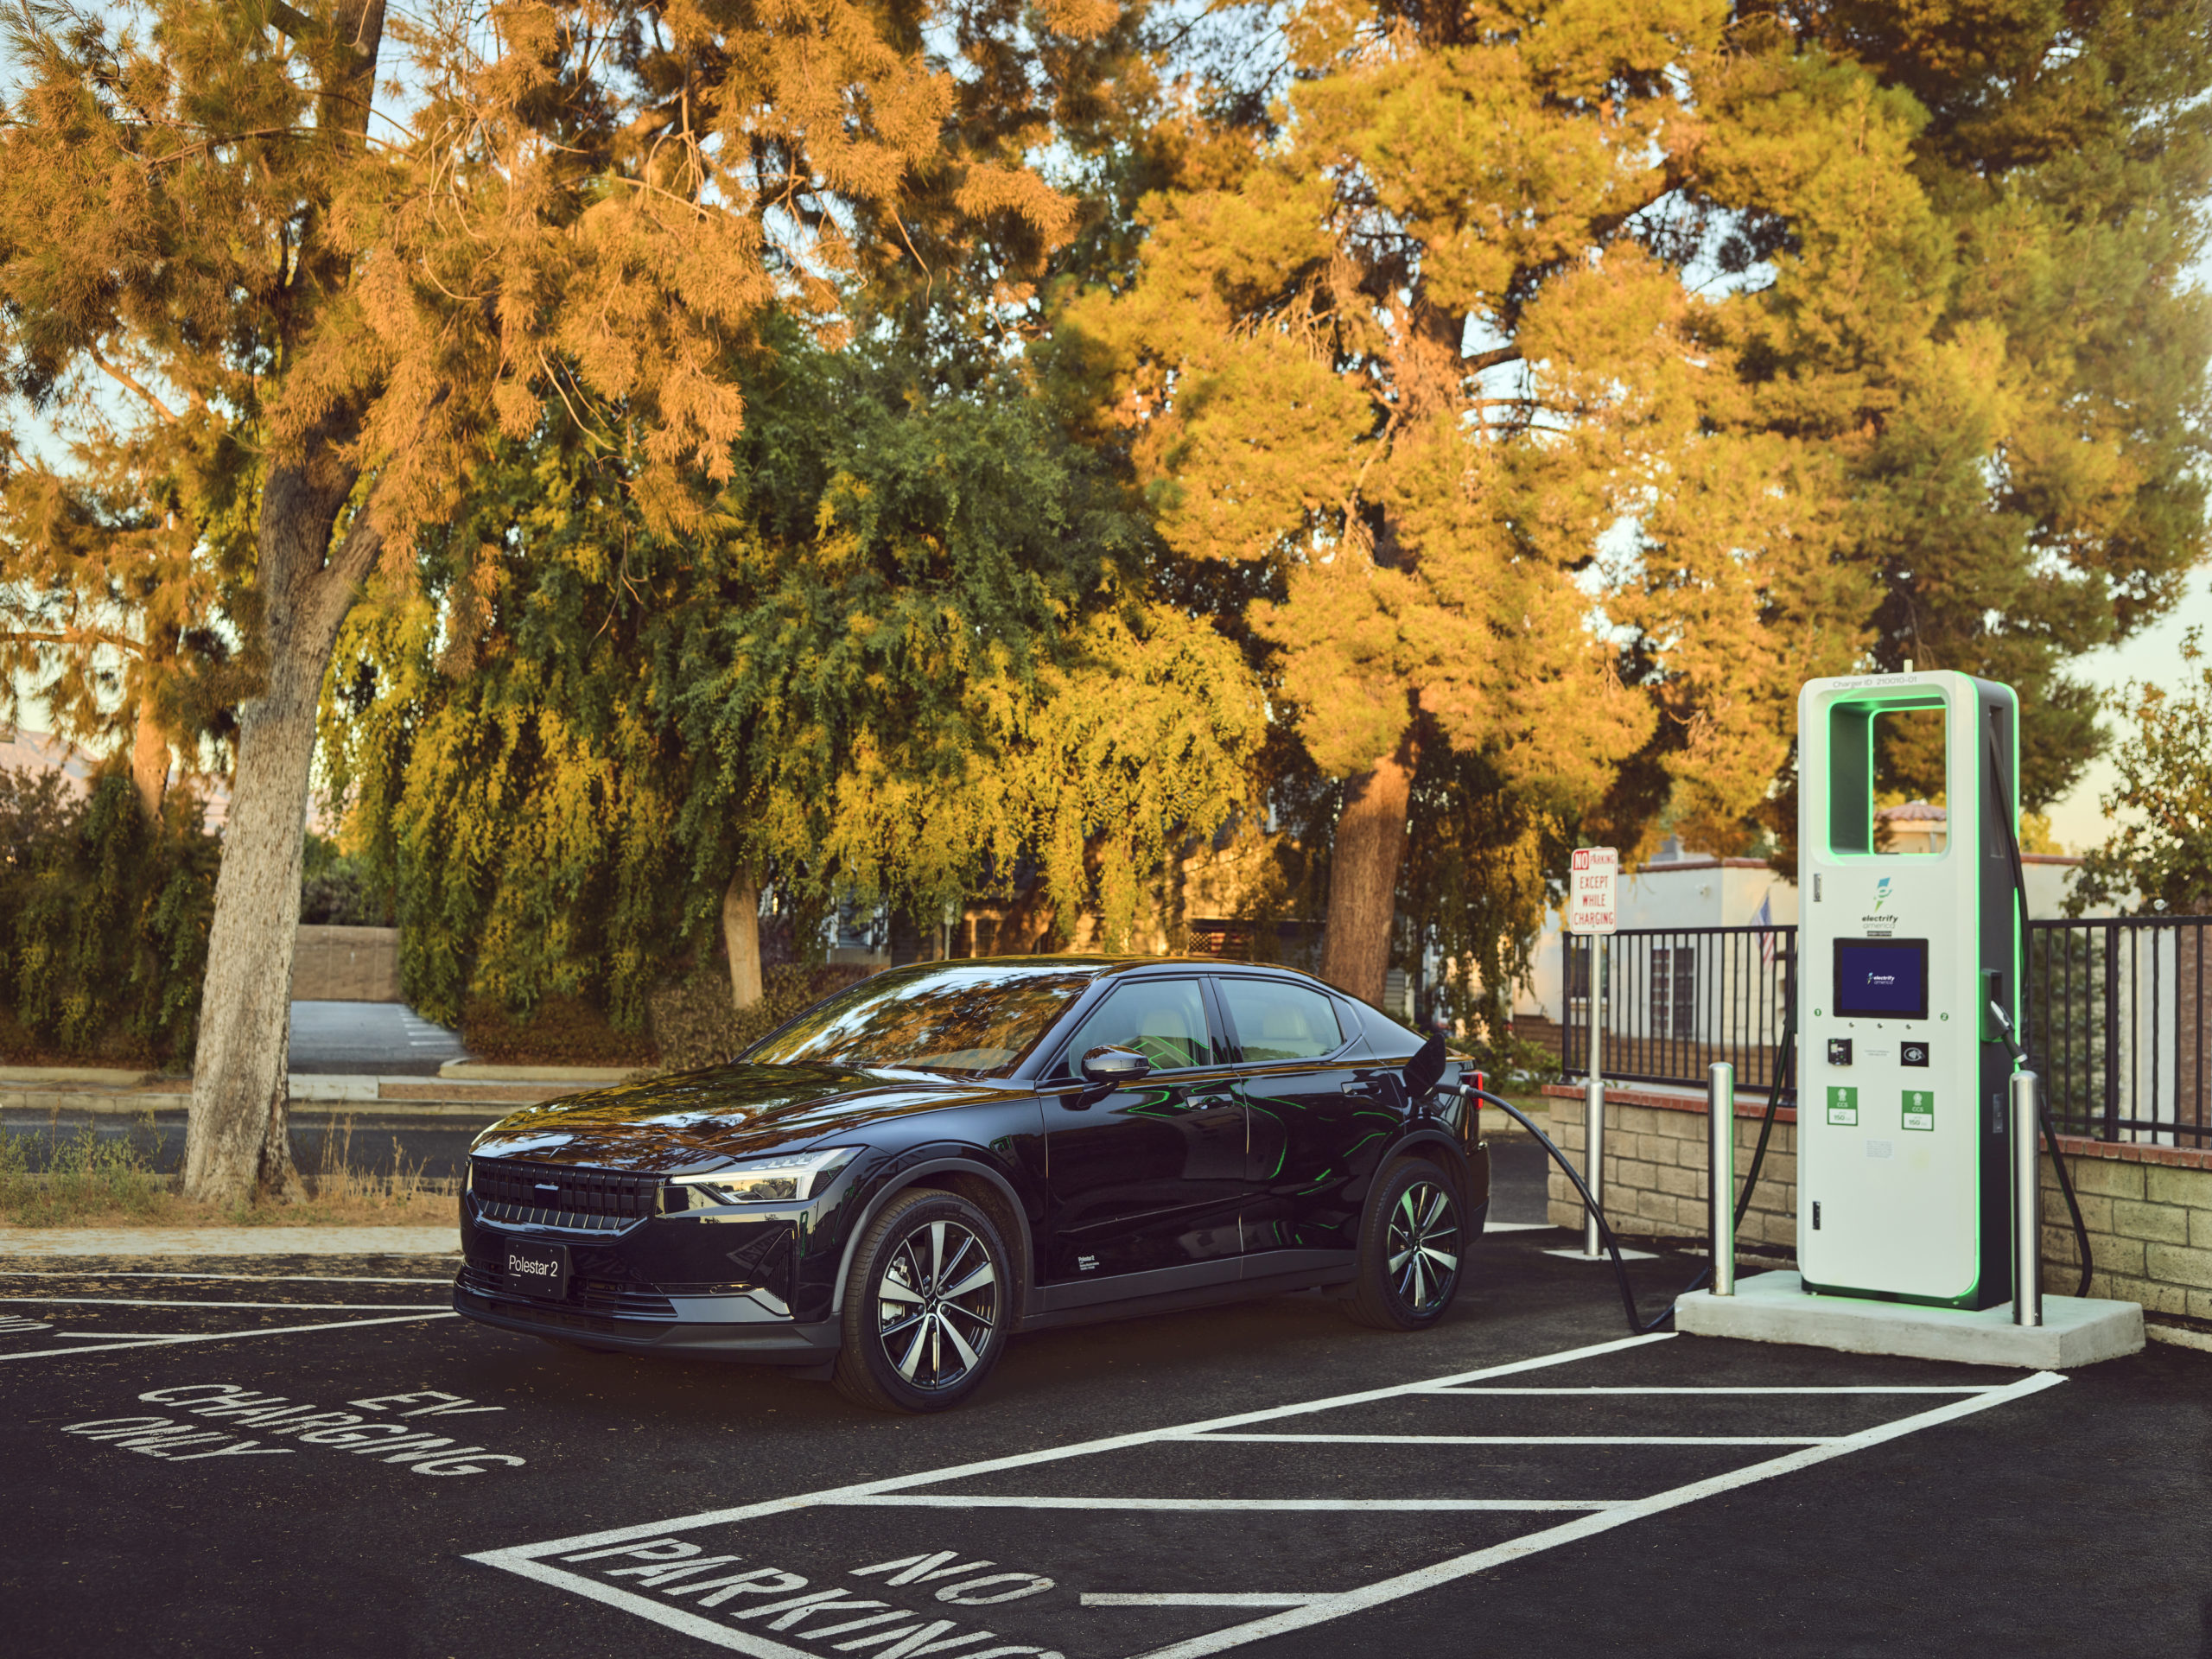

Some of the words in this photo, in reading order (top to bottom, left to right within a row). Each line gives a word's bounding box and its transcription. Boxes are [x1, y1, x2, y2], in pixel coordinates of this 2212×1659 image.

[1833, 680, 1862, 689] Charger
[1574, 852, 1588, 869] NO
[1590, 854, 1614, 865] PARKING
[1580, 875, 1608, 889] EXCEPT
[1582, 893, 1605, 906] WHILE
[1573, 912, 1613, 925] CHARGING
[1862, 914, 1898, 924] electrify
[509, 1255, 549, 1275] Polestar
[550, 1261, 558, 1277] 2
[346, 1390, 507, 1417] EV
[138, 1384, 526, 1476] CHARGING
[60, 1417, 296, 1461] ONLY
[849, 1551, 1057, 1605] NO
